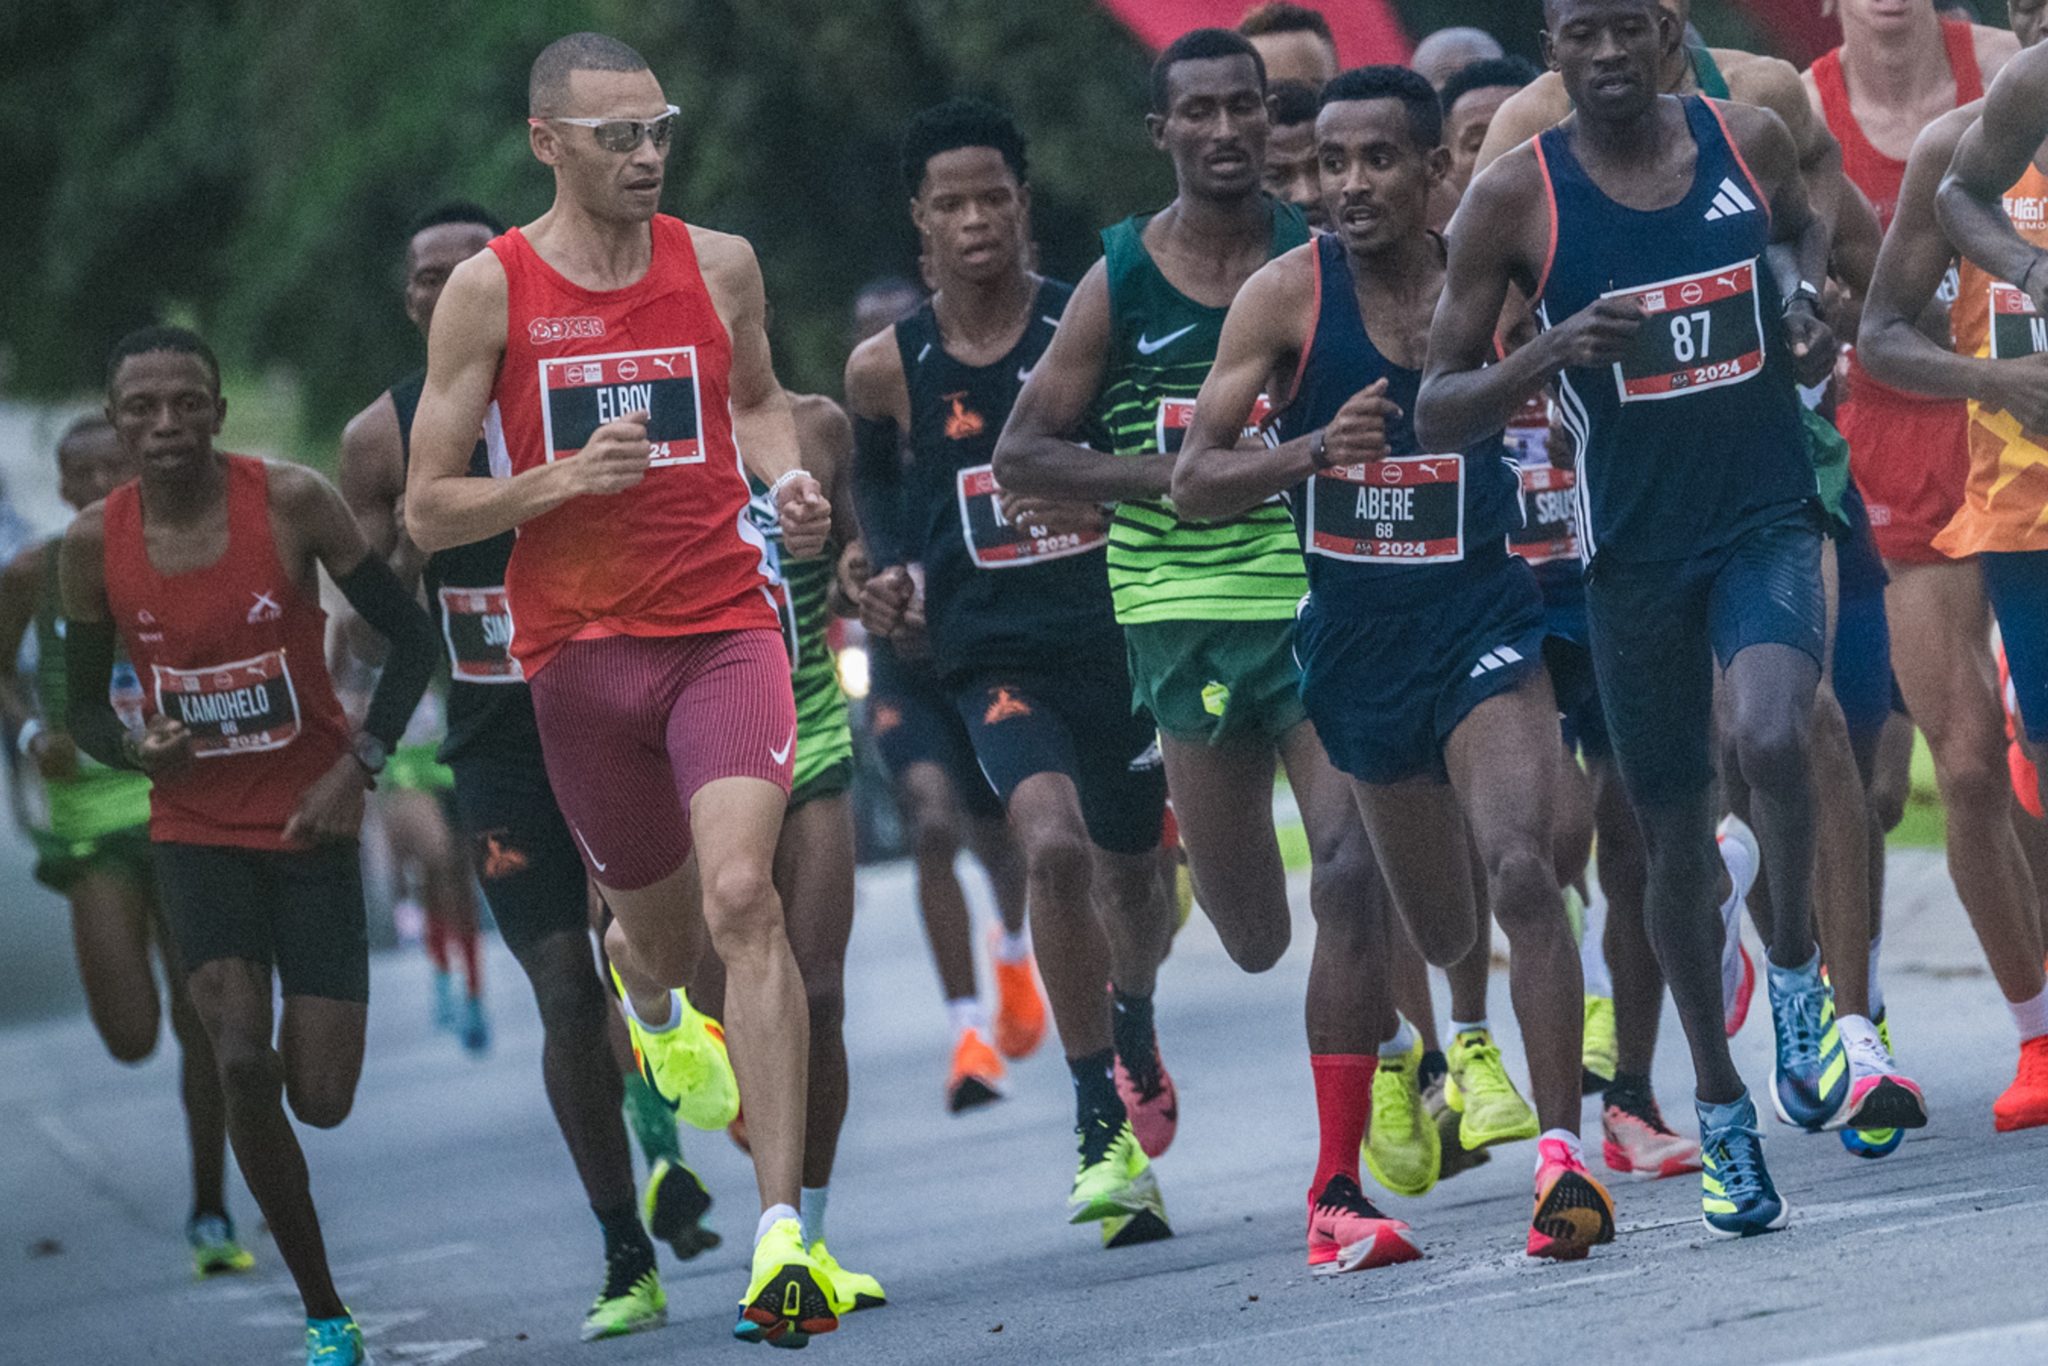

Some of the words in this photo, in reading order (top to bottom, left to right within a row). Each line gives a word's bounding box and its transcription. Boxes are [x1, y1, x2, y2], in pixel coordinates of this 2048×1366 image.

[528, 316, 606, 345] BOXER
[1669, 310, 1711, 363] 87
[1694, 359, 1742, 384] 2024
[596, 383, 652, 424] ELROY
[649, 442, 671, 458] 24
[1355, 486, 1415, 521] ABERE
[1036, 532, 1080, 554] 2024
[1375, 522, 1394, 539] 68
[1378, 541, 1427, 556] 2024
[178, 683, 271, 724] KAMOHELO
[227, 730, 272, 749] 2024
